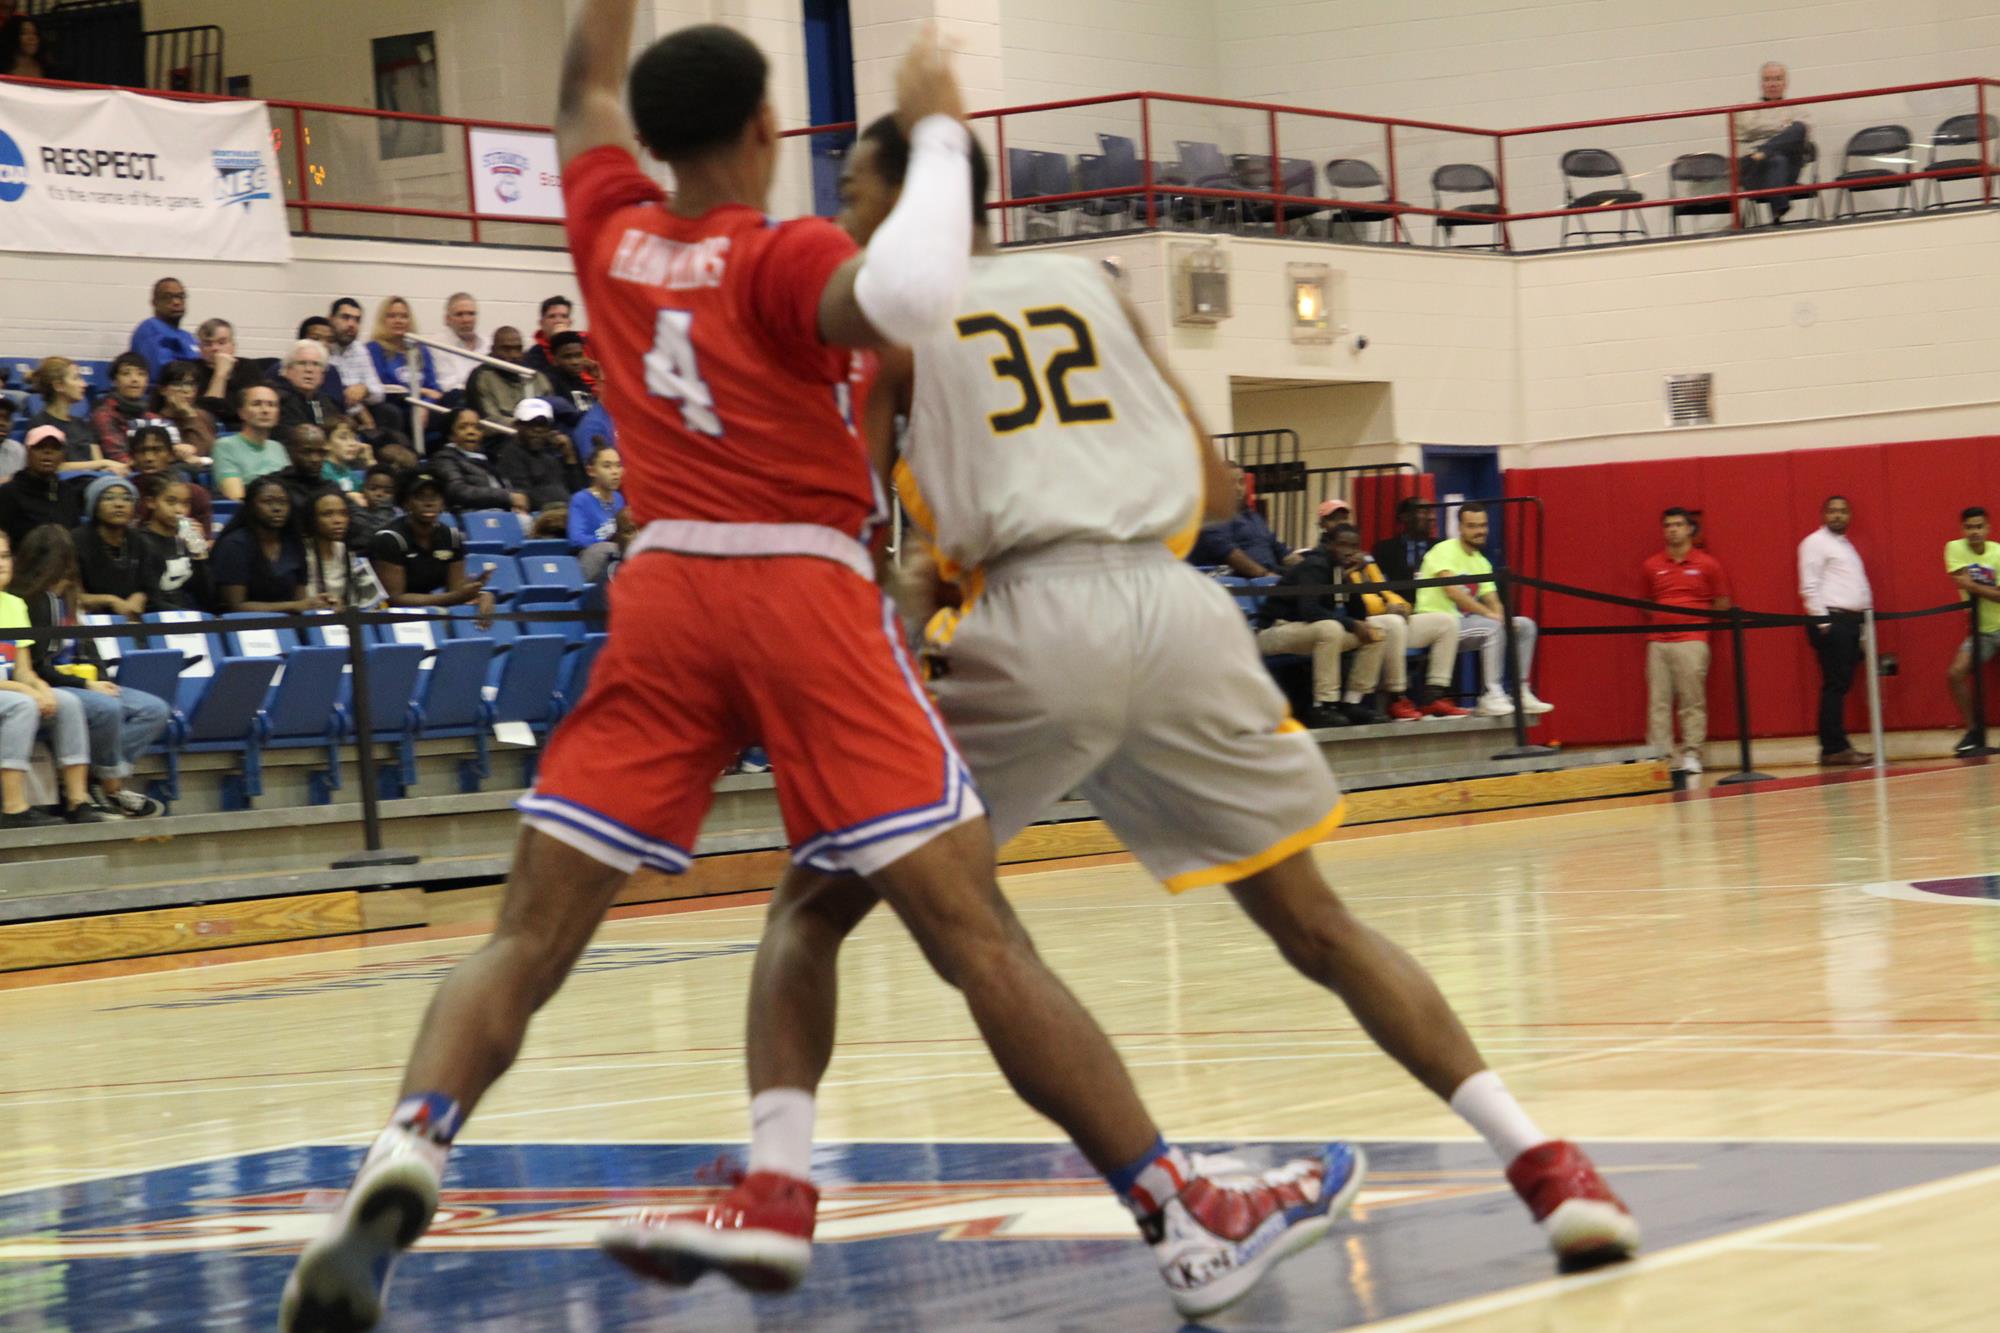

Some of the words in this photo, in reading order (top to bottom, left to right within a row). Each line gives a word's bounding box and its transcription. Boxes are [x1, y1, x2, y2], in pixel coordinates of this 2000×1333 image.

[40, 146, 165, 181] RESPECT.
[643, 308, 724, 437] 4
[954, 304, 1117, 436] 32
